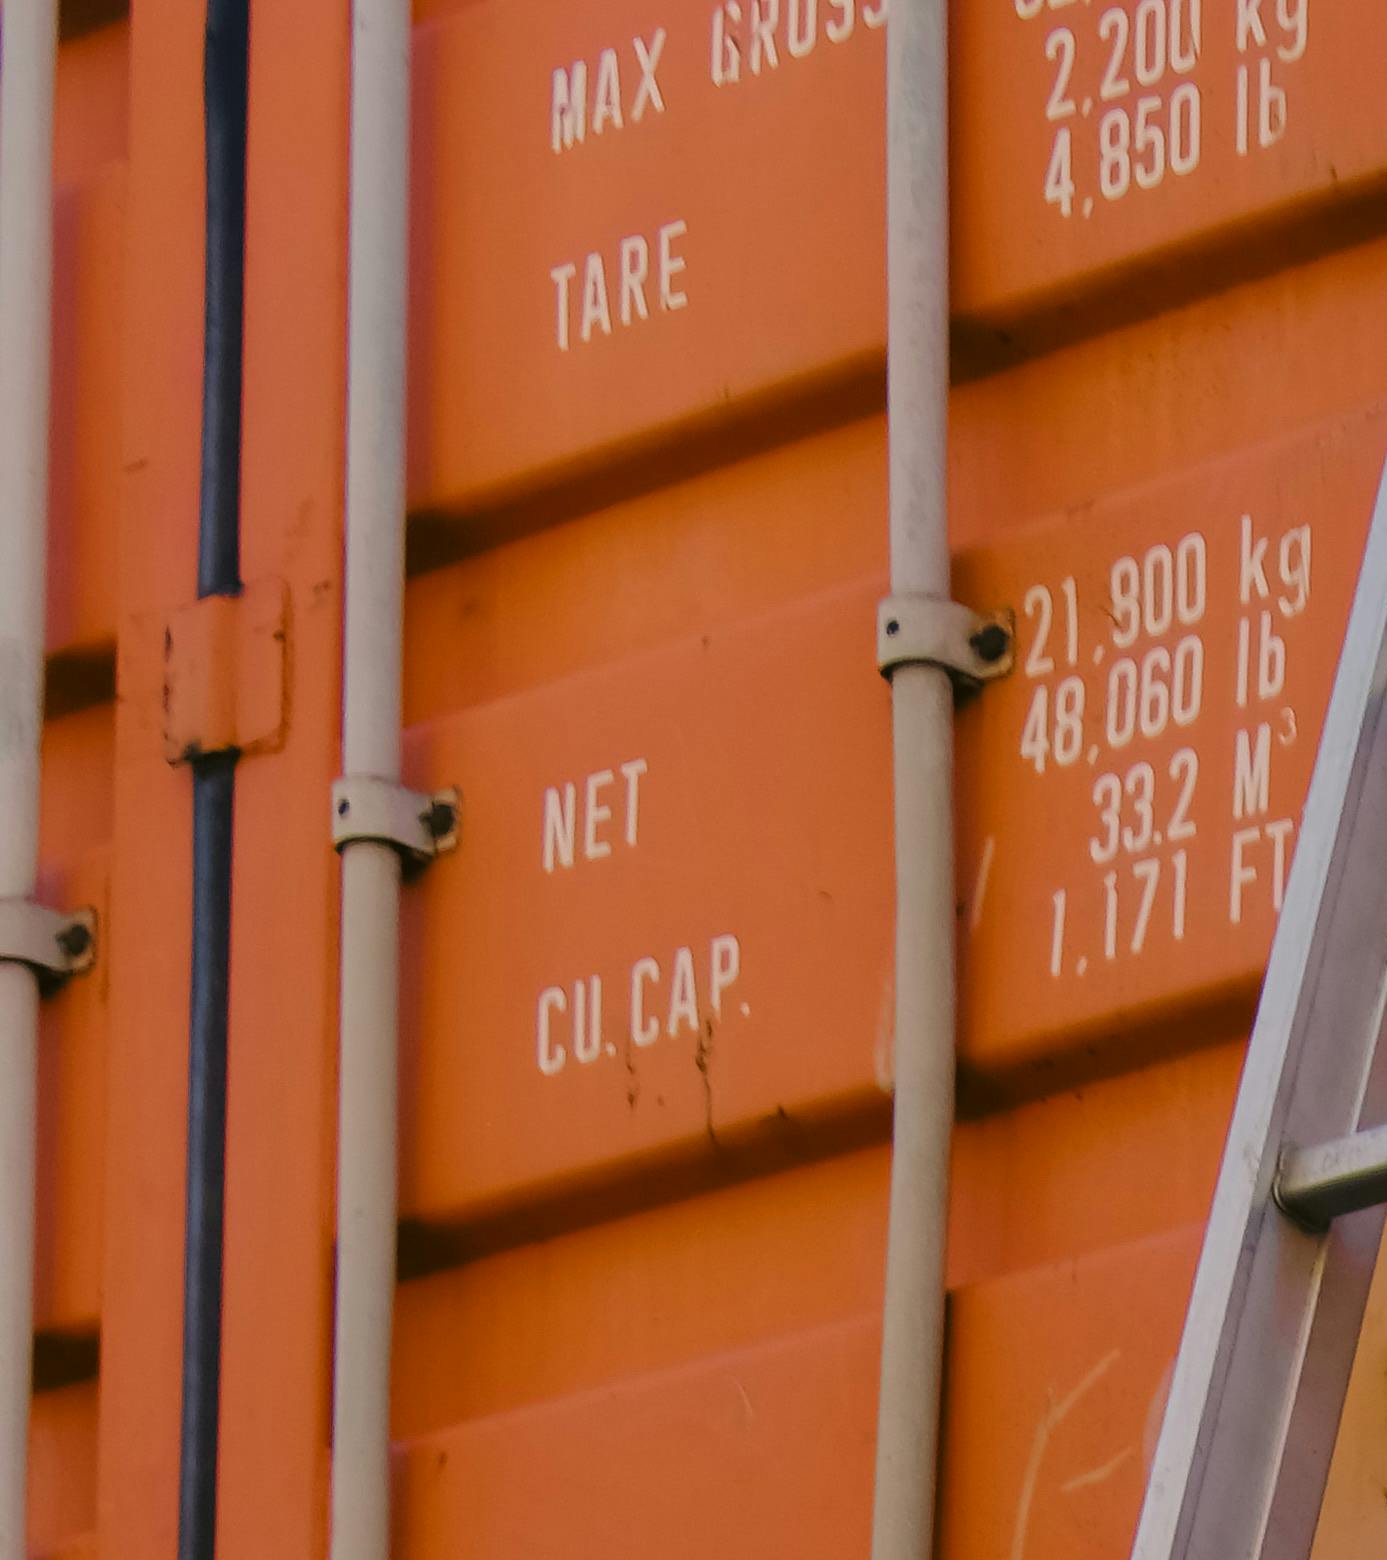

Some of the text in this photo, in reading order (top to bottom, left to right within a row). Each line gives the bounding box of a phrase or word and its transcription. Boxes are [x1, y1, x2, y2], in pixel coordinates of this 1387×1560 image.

[551, 26, 667, 154] MAX
[1043, 56, 1288, 219] 4,850 lb
[549, 218, 689, 352] TARE
[1023, 513, 1312, 679] 21,900 kg
[1019, 608, 1286, 774] 48,060 lb
[541, 757, 649, 874] NET
[1089, 745, 1200, 865] 33.2
